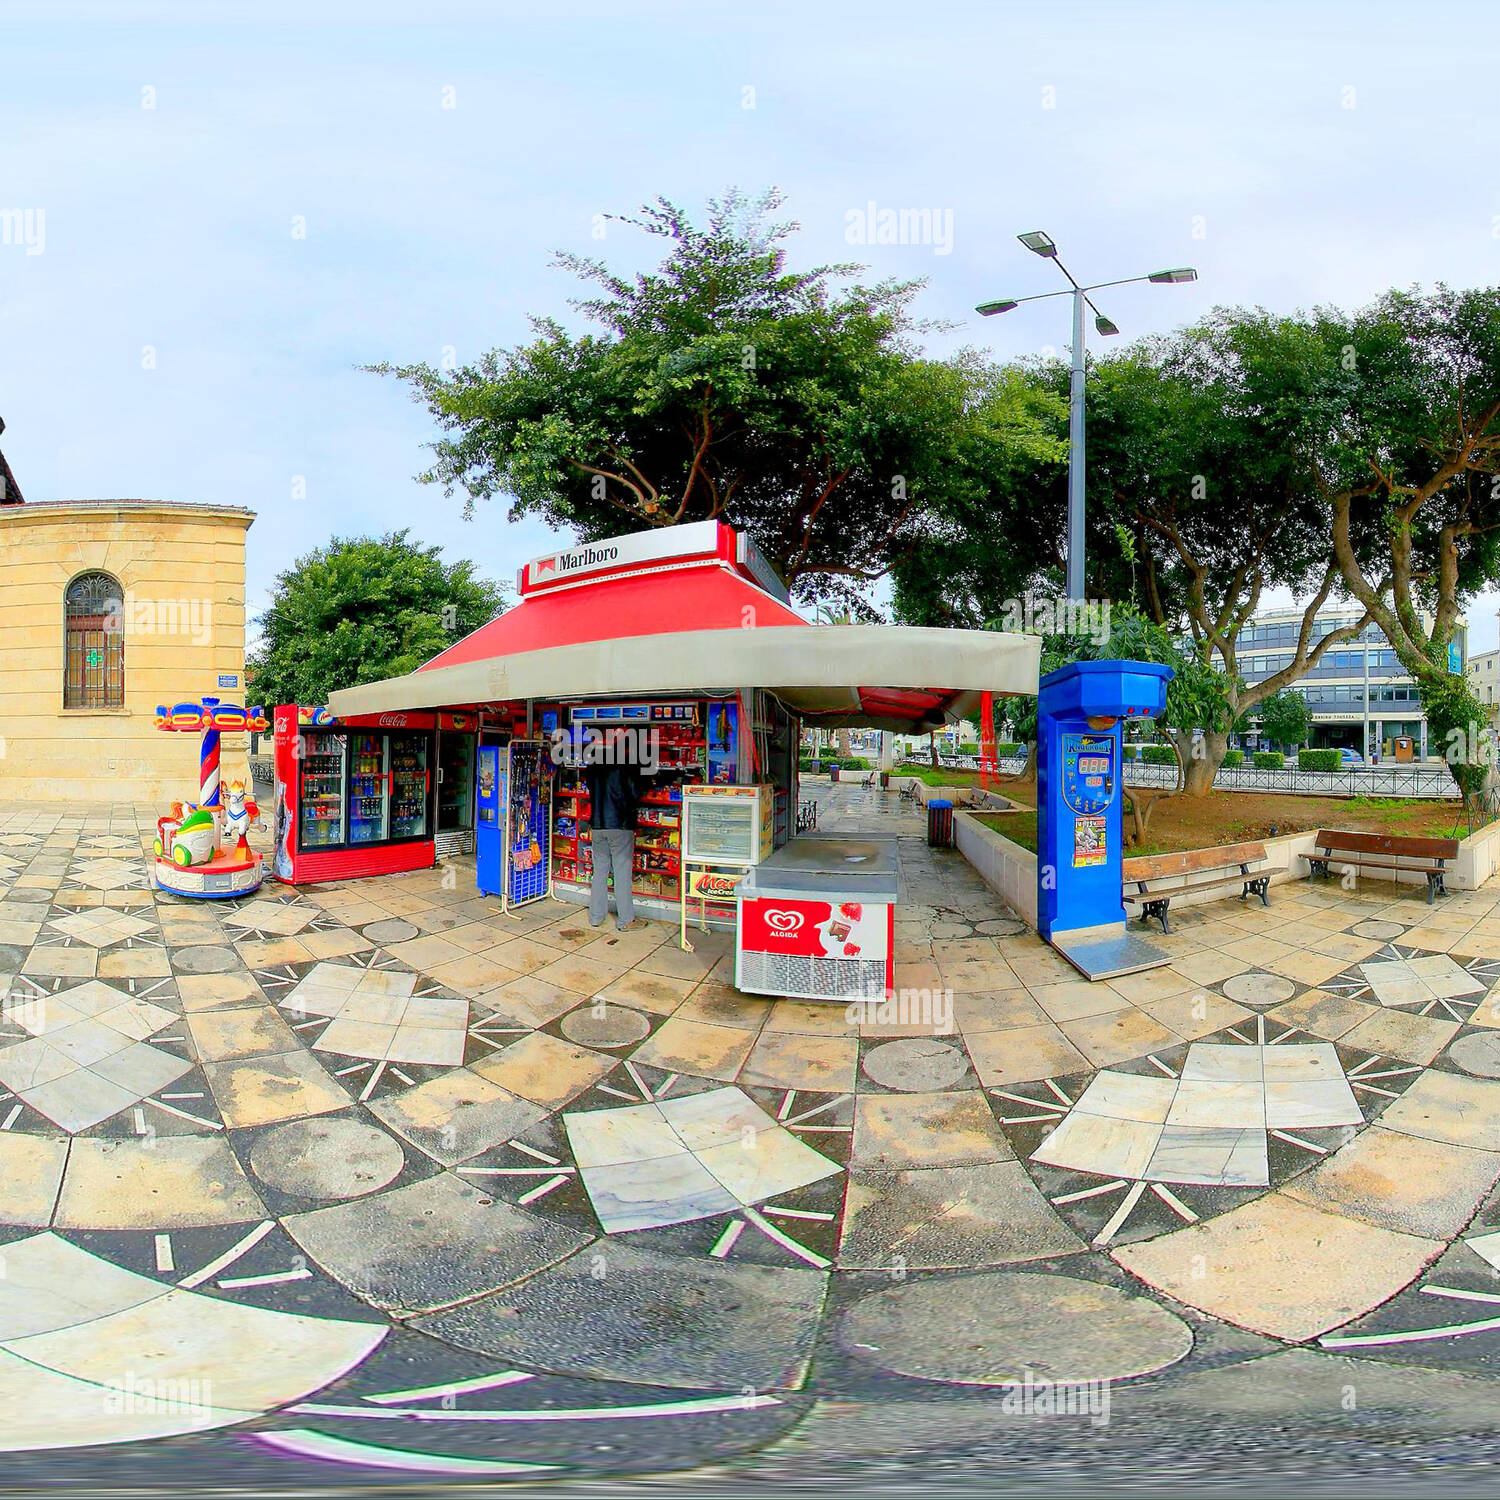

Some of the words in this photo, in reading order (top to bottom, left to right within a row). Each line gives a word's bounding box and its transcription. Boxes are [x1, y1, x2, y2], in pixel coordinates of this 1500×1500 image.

[559, 546, 618, 571] Marlboro
[695, 873, 737, 890] Mar
[769, 931, 799, 939] ALGIDA
